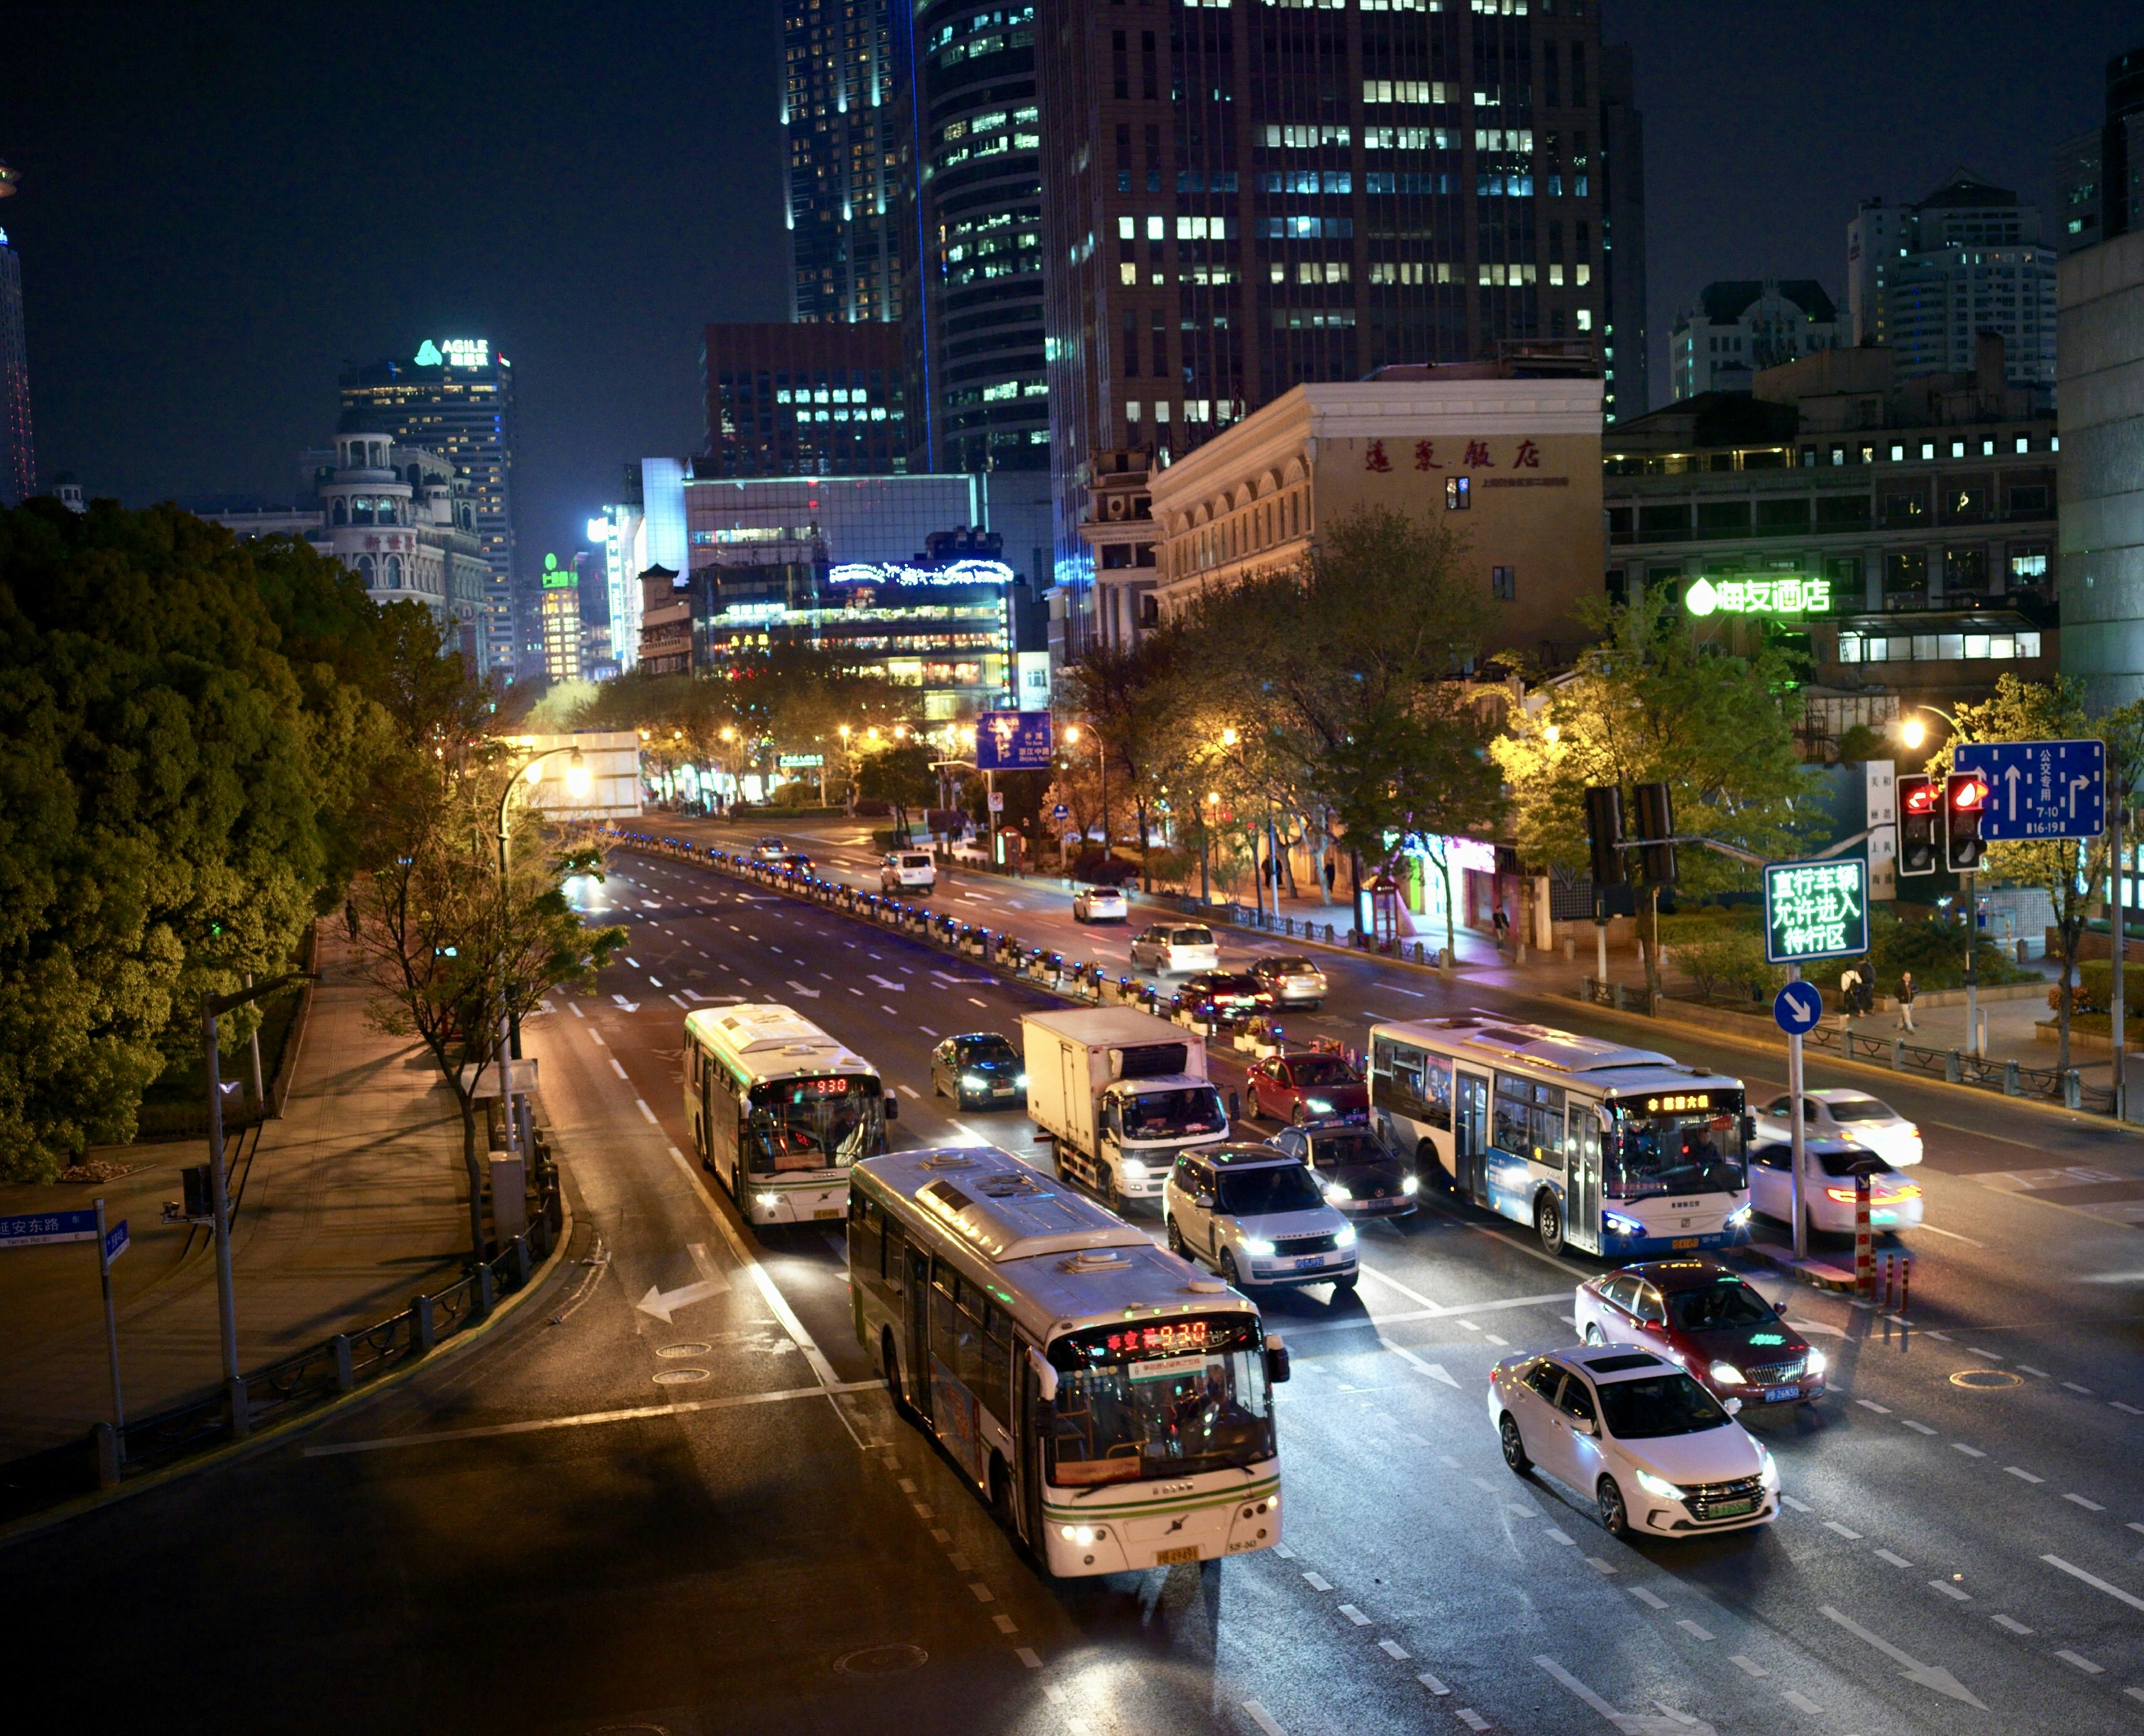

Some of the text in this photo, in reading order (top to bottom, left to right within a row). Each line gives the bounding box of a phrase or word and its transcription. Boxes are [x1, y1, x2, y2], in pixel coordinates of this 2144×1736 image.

[441, 339, 488, 353] AGILE
[1717, 578, 1830, 613] 海友酒店
[2040, 749, 2051, 802] 公交专用
[2037, 806, 2059, 818] 7-10
[2033, 822, 2059, 833] 16-19
[1773, 864, 1859, 899] 直行车辆
[1773, 891, 1860, 929] 允许进入
[1784, 922, 1847, 954] 待行区
[818, 1079, 846, 1094] 930
[0, 1215, 80, 1235] 延安东路 东
[1160, 1322, 1206, 1347] 930
